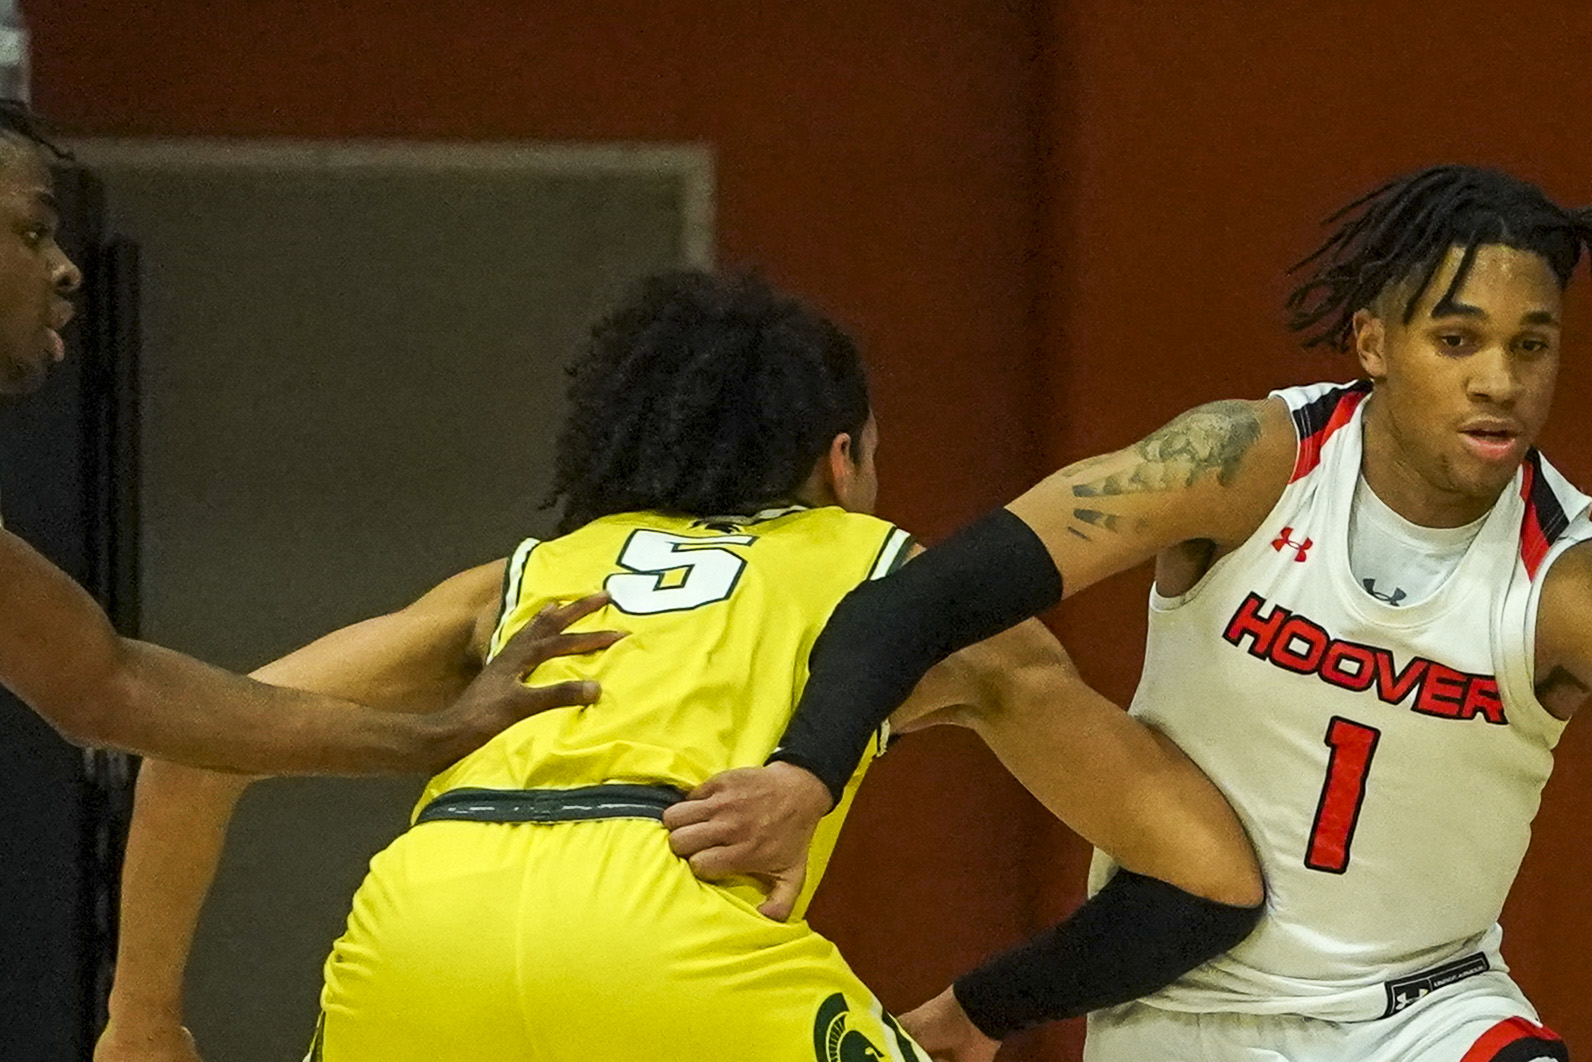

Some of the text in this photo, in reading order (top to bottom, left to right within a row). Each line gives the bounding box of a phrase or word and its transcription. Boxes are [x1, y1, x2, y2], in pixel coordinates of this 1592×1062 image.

[603, 528, 760, 615] 5
[1222, 591, 1510, 725] HOOVER
[1304, 716, 1381, 874] 1
